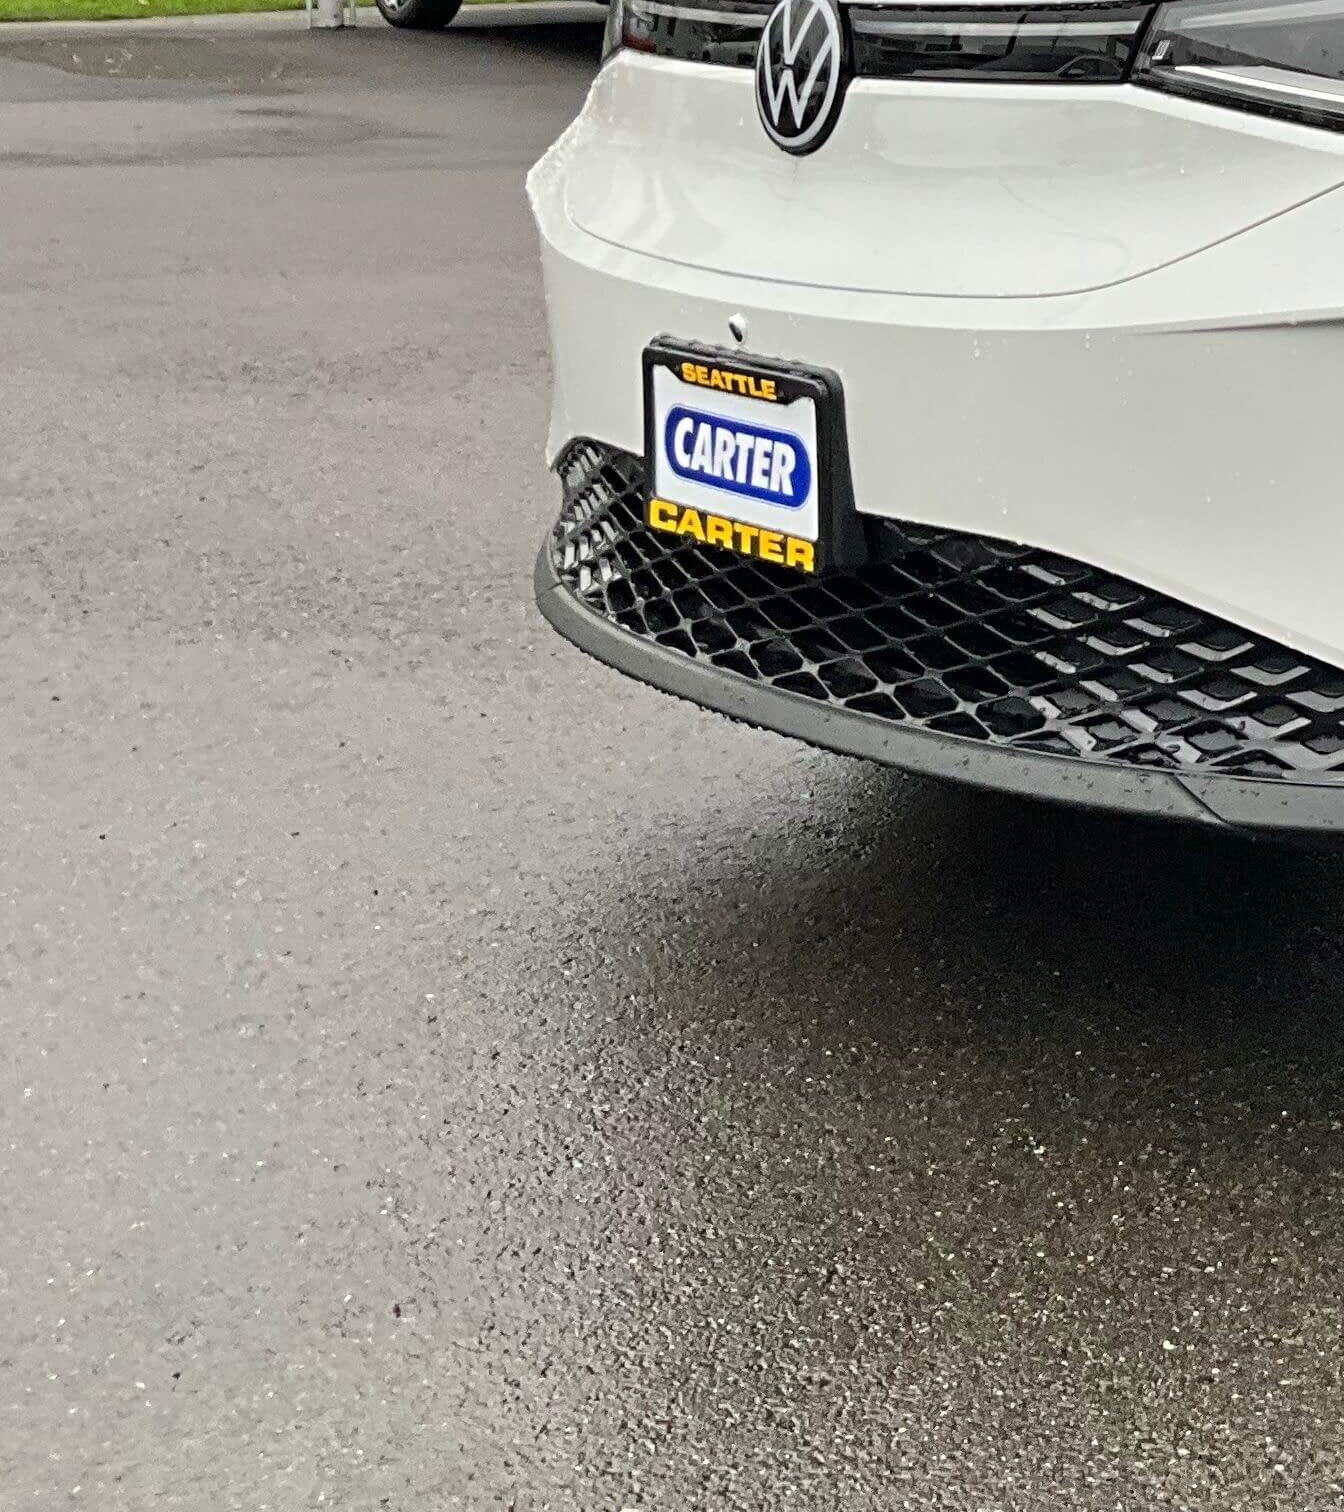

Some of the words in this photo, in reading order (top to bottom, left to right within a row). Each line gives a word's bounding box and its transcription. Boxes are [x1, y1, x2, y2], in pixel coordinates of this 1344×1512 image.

[681, 362, 777, 400] SEATTLE
[674, 417, 796, 496] CARTER
[649, 497, 815, 573] CARTER
